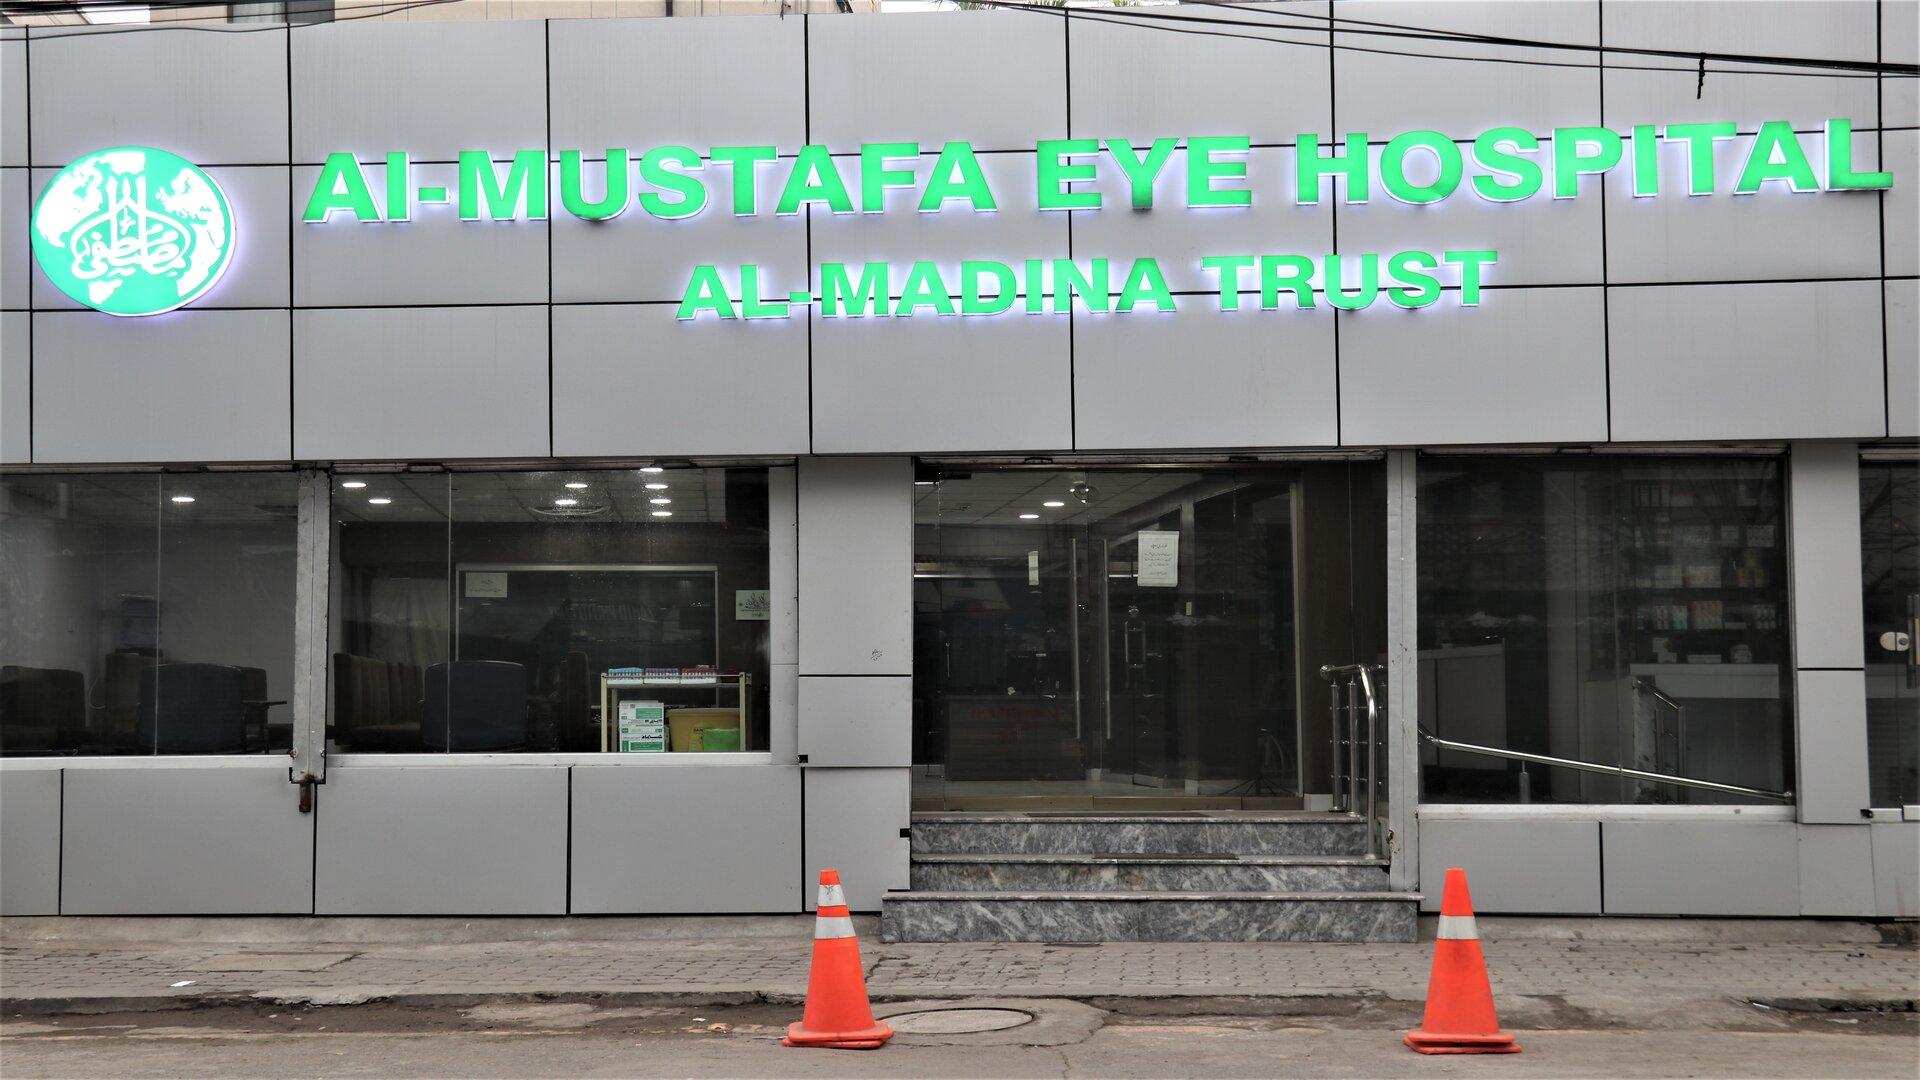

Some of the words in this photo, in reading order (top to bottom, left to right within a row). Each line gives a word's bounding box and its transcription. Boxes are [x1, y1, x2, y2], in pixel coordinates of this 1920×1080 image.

[1036, 136, 1254, 210] EYE
[1295, 118, 1895, 206] HOSPITAL
[676, 258, 1177, 321] AL-MADINA
[1201, 250, 1499, 313] TRUST
